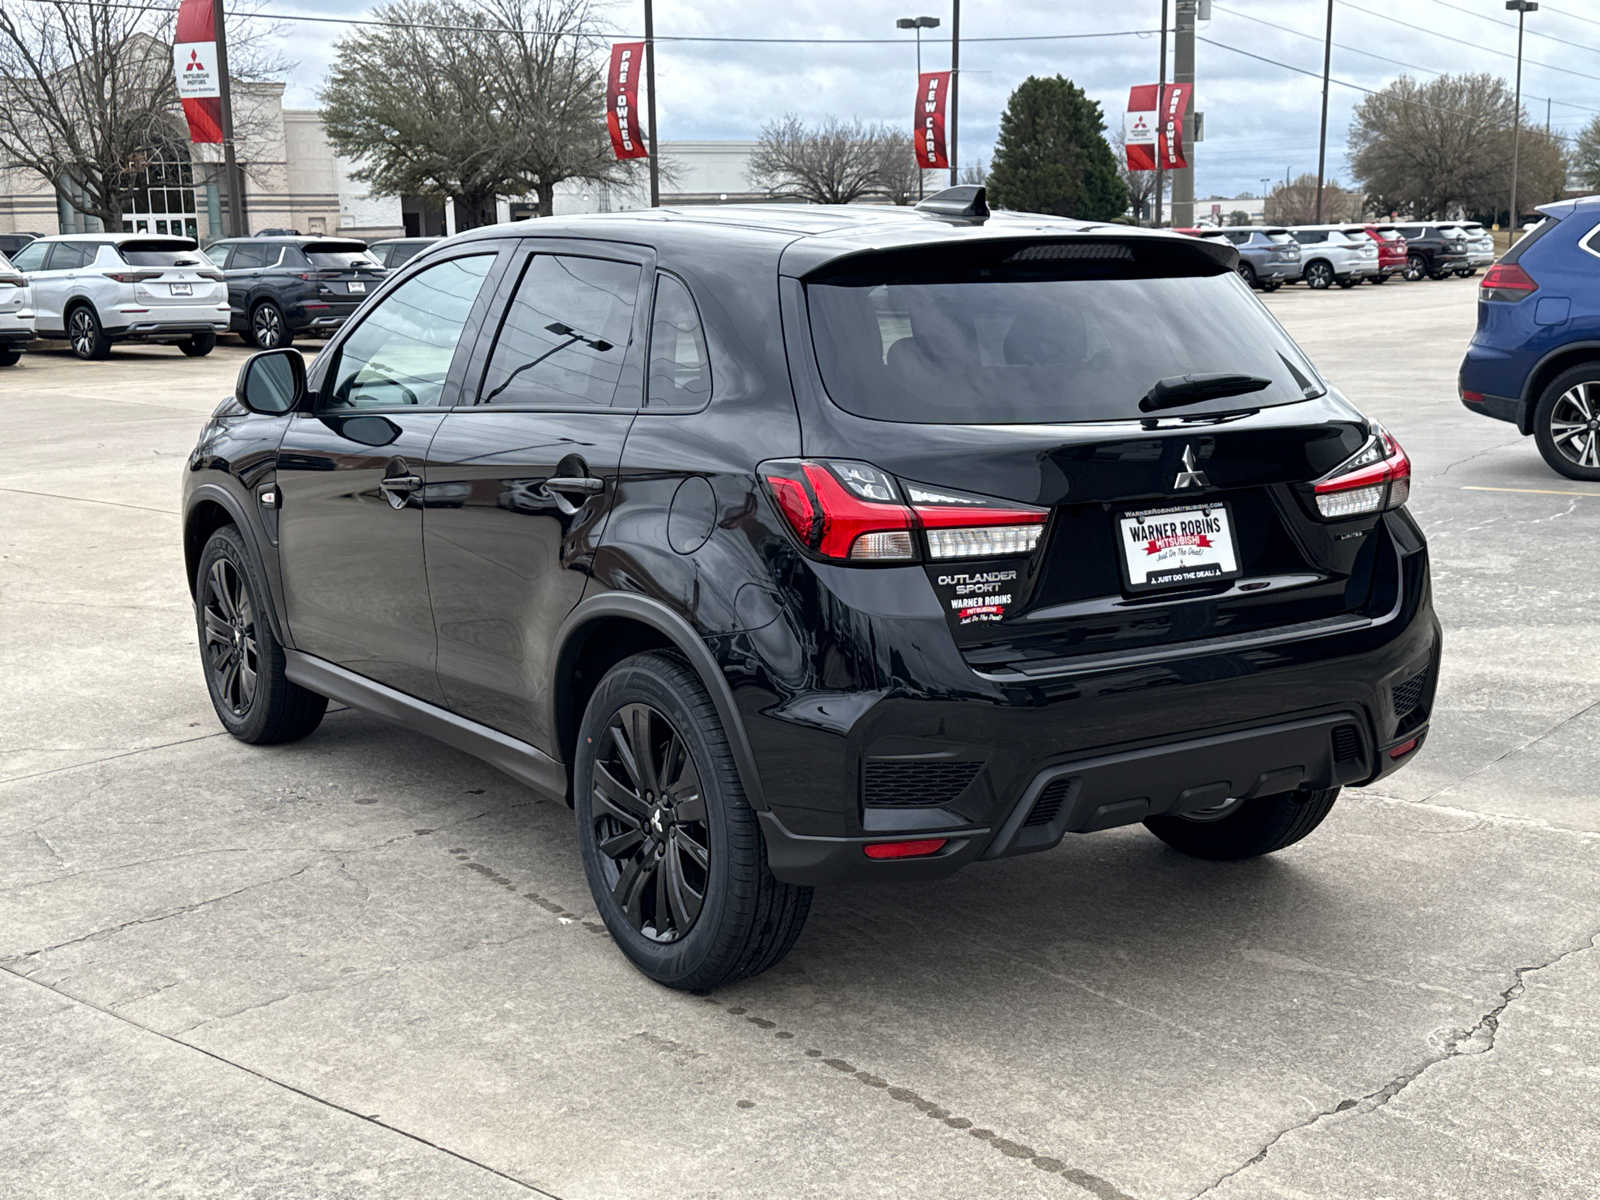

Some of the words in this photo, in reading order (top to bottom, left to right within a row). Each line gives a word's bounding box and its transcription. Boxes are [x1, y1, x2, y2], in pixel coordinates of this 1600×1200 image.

[615, 50, 634, 151] PRE-OWNED
[925, 79, 939, 113] NEW
[925, 117, 937, 163] CARS
[1129, 522, 1178, 542] WARNER
[1180, 517, 1221, 536] ROBINS
[1155, 535, 1201, 549] MITSUBISHI
[1156, 552, 1168, 561] Just
[1168, 549, 1177, 558] Do
[1177, 547, 1187, 556] The
[937, 570, 1017, 585] OUTLANDER
[1157, 575, 1173, 583] JUST
[1173, 573, 1182, 581] DO
[1196, 569, 1215, 578] DEAL!
[955, 582, 1002, 595] SPORT
[951, 596, 984, 609] WARNER
[984, 594, 1012, 606] ROBINS
